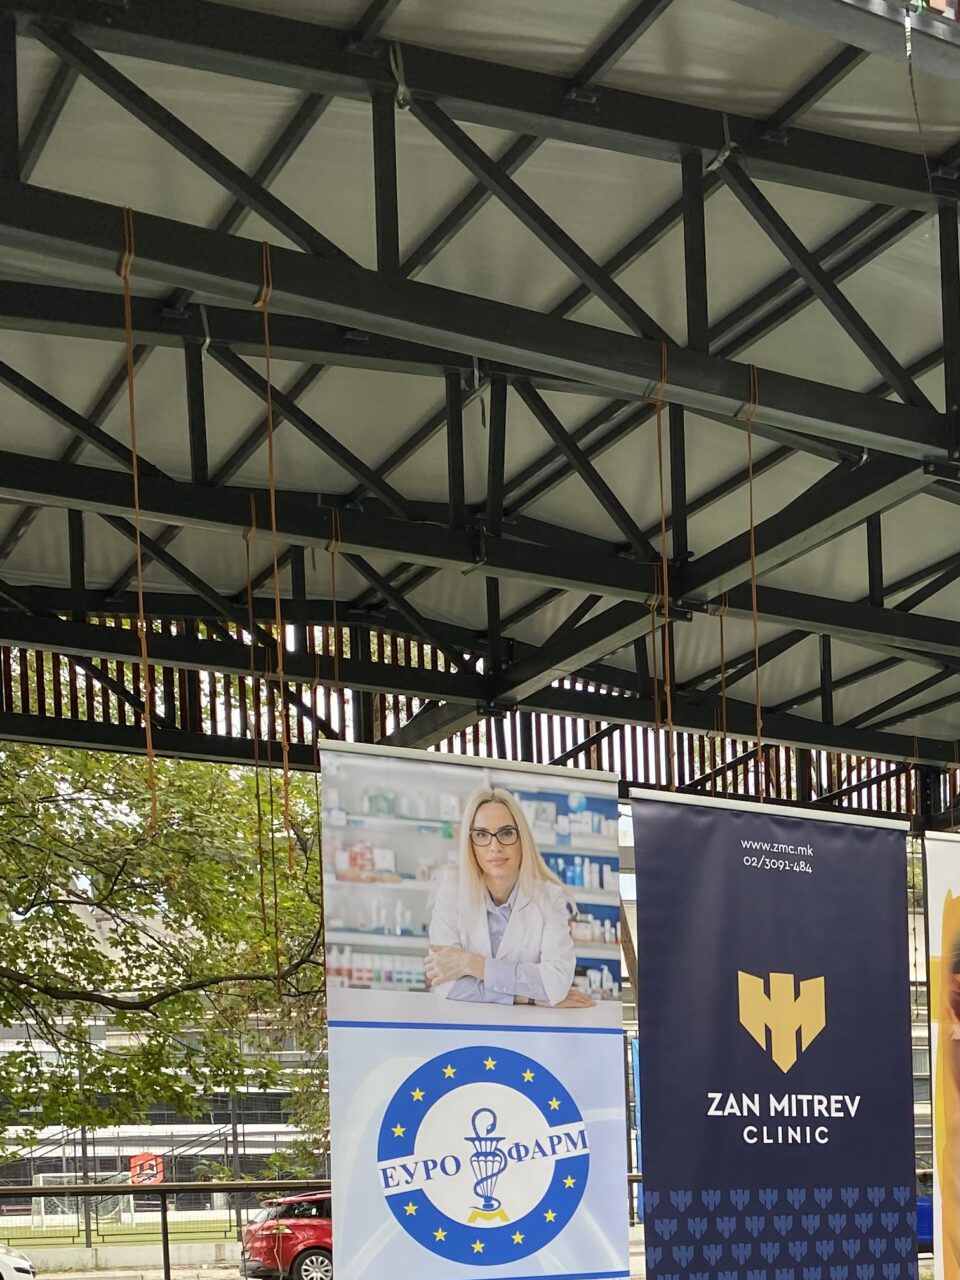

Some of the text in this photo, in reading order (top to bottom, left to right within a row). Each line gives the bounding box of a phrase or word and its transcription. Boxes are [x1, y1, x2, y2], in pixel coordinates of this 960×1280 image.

[741, 839, 814, 856] www.zmc.mk
[743, 856, 813, 874] 02/3091-484
[707, 1092, 861, 1118] ZAN MITREV
[743, 1125, 829, 1145] CLINIC
[380, 1129, 590, 1189] ЕУРО ФАРМ
